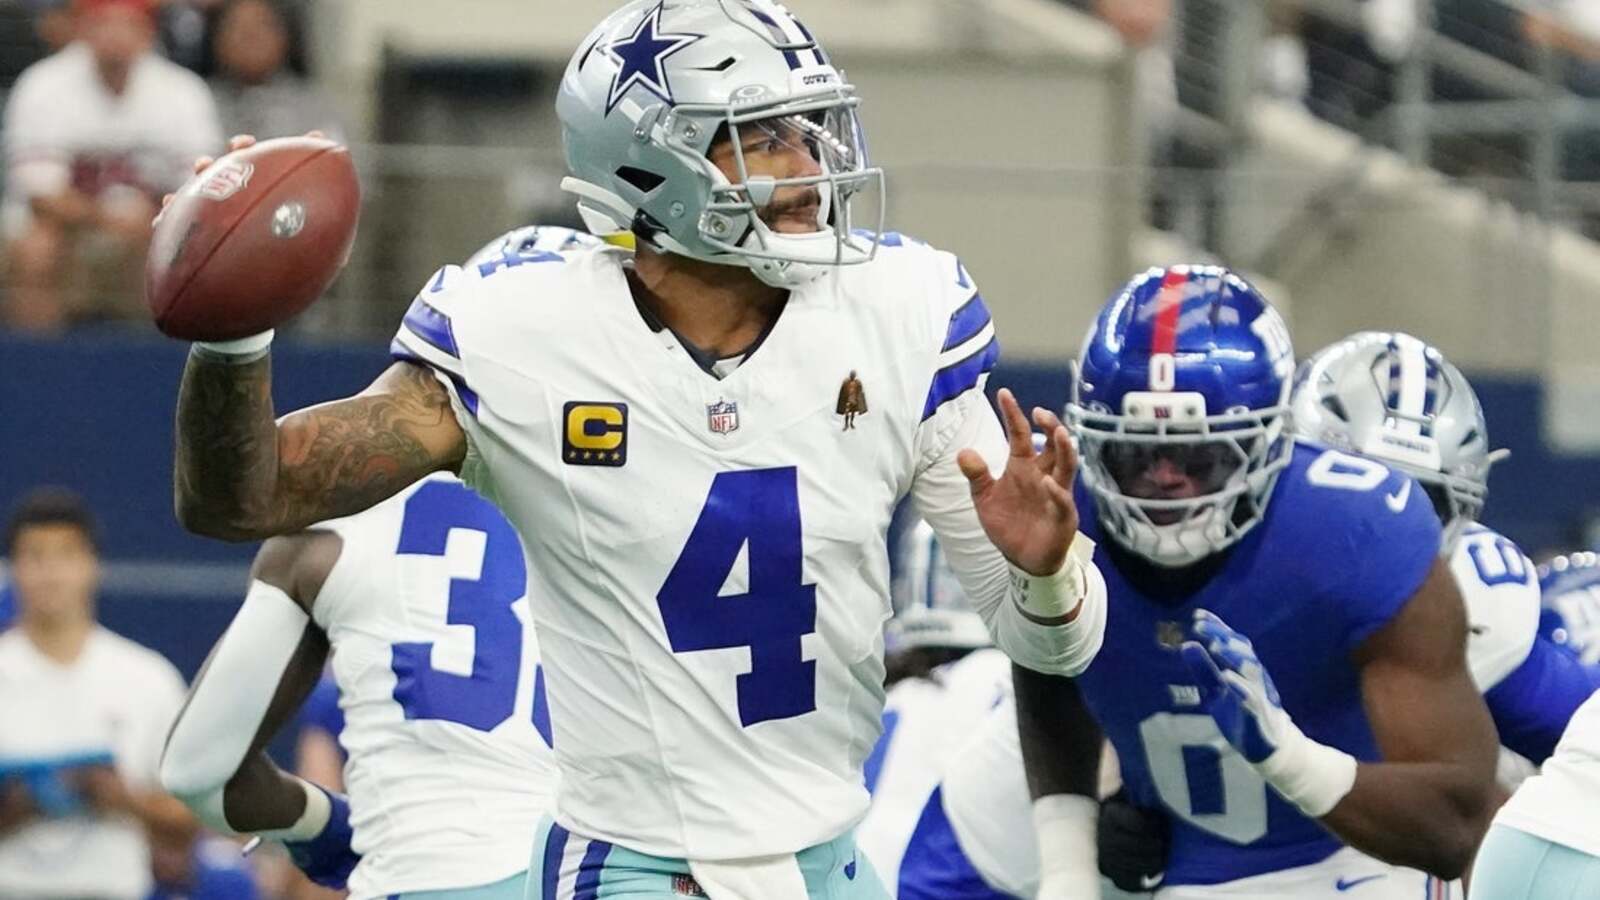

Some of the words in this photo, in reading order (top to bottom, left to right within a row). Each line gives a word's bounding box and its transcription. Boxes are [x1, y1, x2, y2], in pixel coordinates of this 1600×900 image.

[567, 405, 623, 449] C
[711, 414, 737, 431] NFL
[1307, 450, 1390, 491] 0
[391, 479, 554, 750] 3
[656, 465, 818, 728] 4
[1139, 711, 1268, 846] 0
